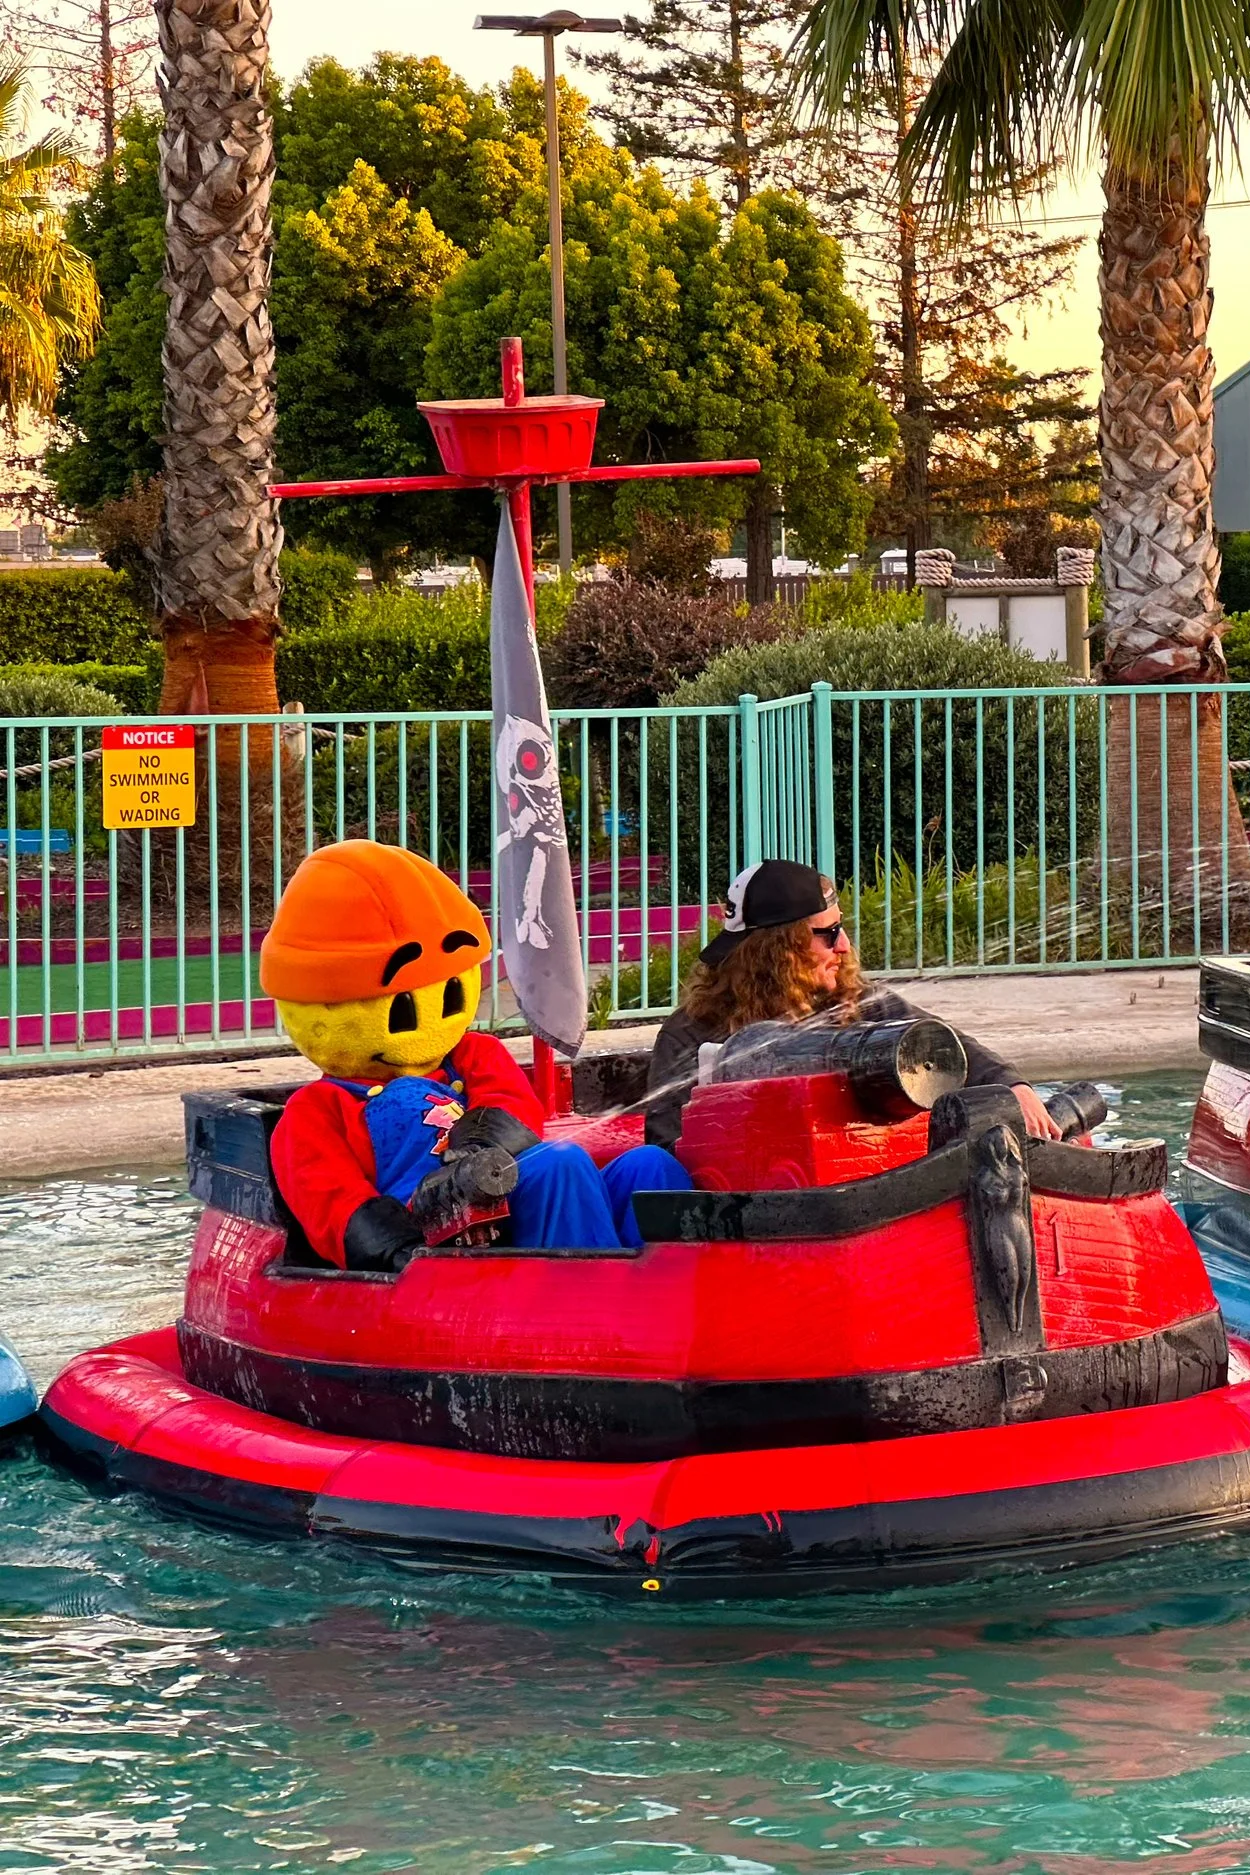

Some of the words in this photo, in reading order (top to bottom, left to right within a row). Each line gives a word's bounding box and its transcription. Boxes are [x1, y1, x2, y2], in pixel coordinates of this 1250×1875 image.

[123, 732, 175, 744] NOTICE
[139, 756, 161, 768] NO
[110, 773, 190, 787] SWIMMING
[140, 791, 161, 804] OR
[120, 808, 181, 822] WADING
[1047, 1210, 1069, 1277] 1
